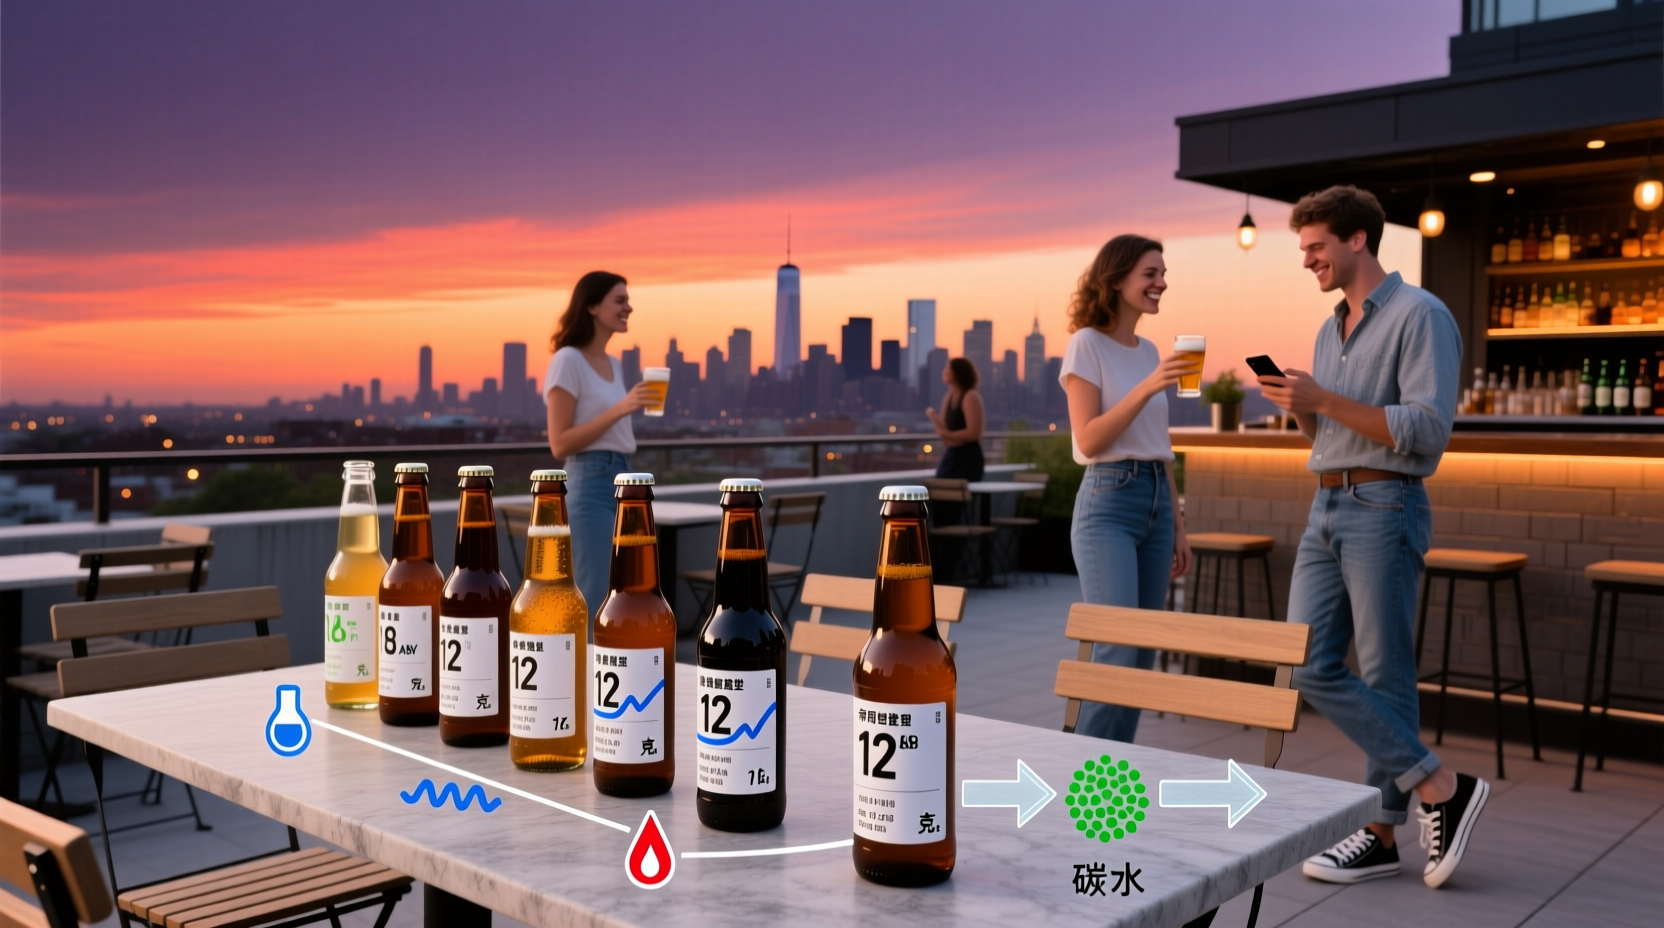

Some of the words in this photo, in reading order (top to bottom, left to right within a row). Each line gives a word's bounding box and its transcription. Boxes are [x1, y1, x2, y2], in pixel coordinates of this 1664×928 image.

[440, 639, 462, 672] 12
[511, 655, 538, 691] 12
[595, 670, 620, 709] 12
[700, 693, 732, 736] 12
[858, 730, 897, 780] 12
